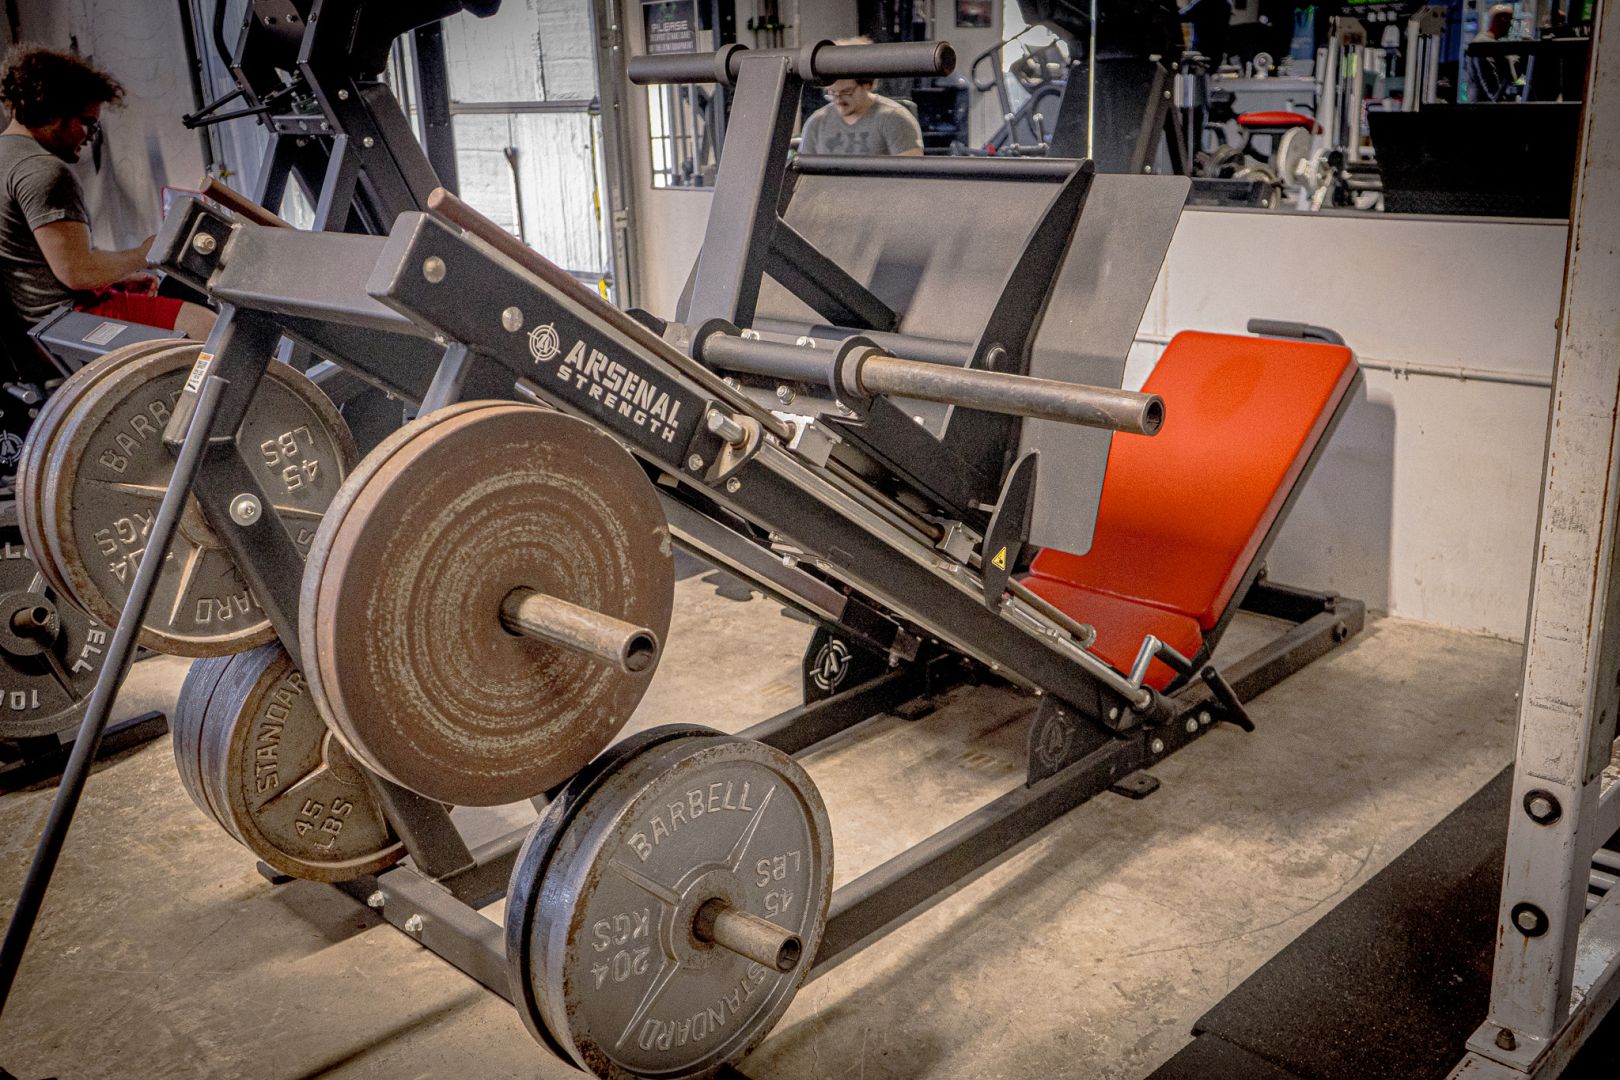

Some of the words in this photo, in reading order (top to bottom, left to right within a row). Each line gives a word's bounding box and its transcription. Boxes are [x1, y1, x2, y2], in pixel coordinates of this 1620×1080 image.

[557, 364, 676, 443] STRENGTH
[564, 340, 681, 429] ARSENAL
[99, 389, 183, 475] BARB
[260, 424, 314, 468] LBS
[283, 459, 319, 493] 45
[94, 508, 155, 556] KGS
[256, 670, 307, 794] STANDAR
[295, 799, 323, 836] 45
[314, 798, 353, 852] LBS
[627, 781, 753, 862] BARBELL
[756, 850, 800, 888] LBS
[764, 886, 794, 919] 45
[592, 907, 650, 952] KGS
[637, 959, 767, 1051] STANDARD
